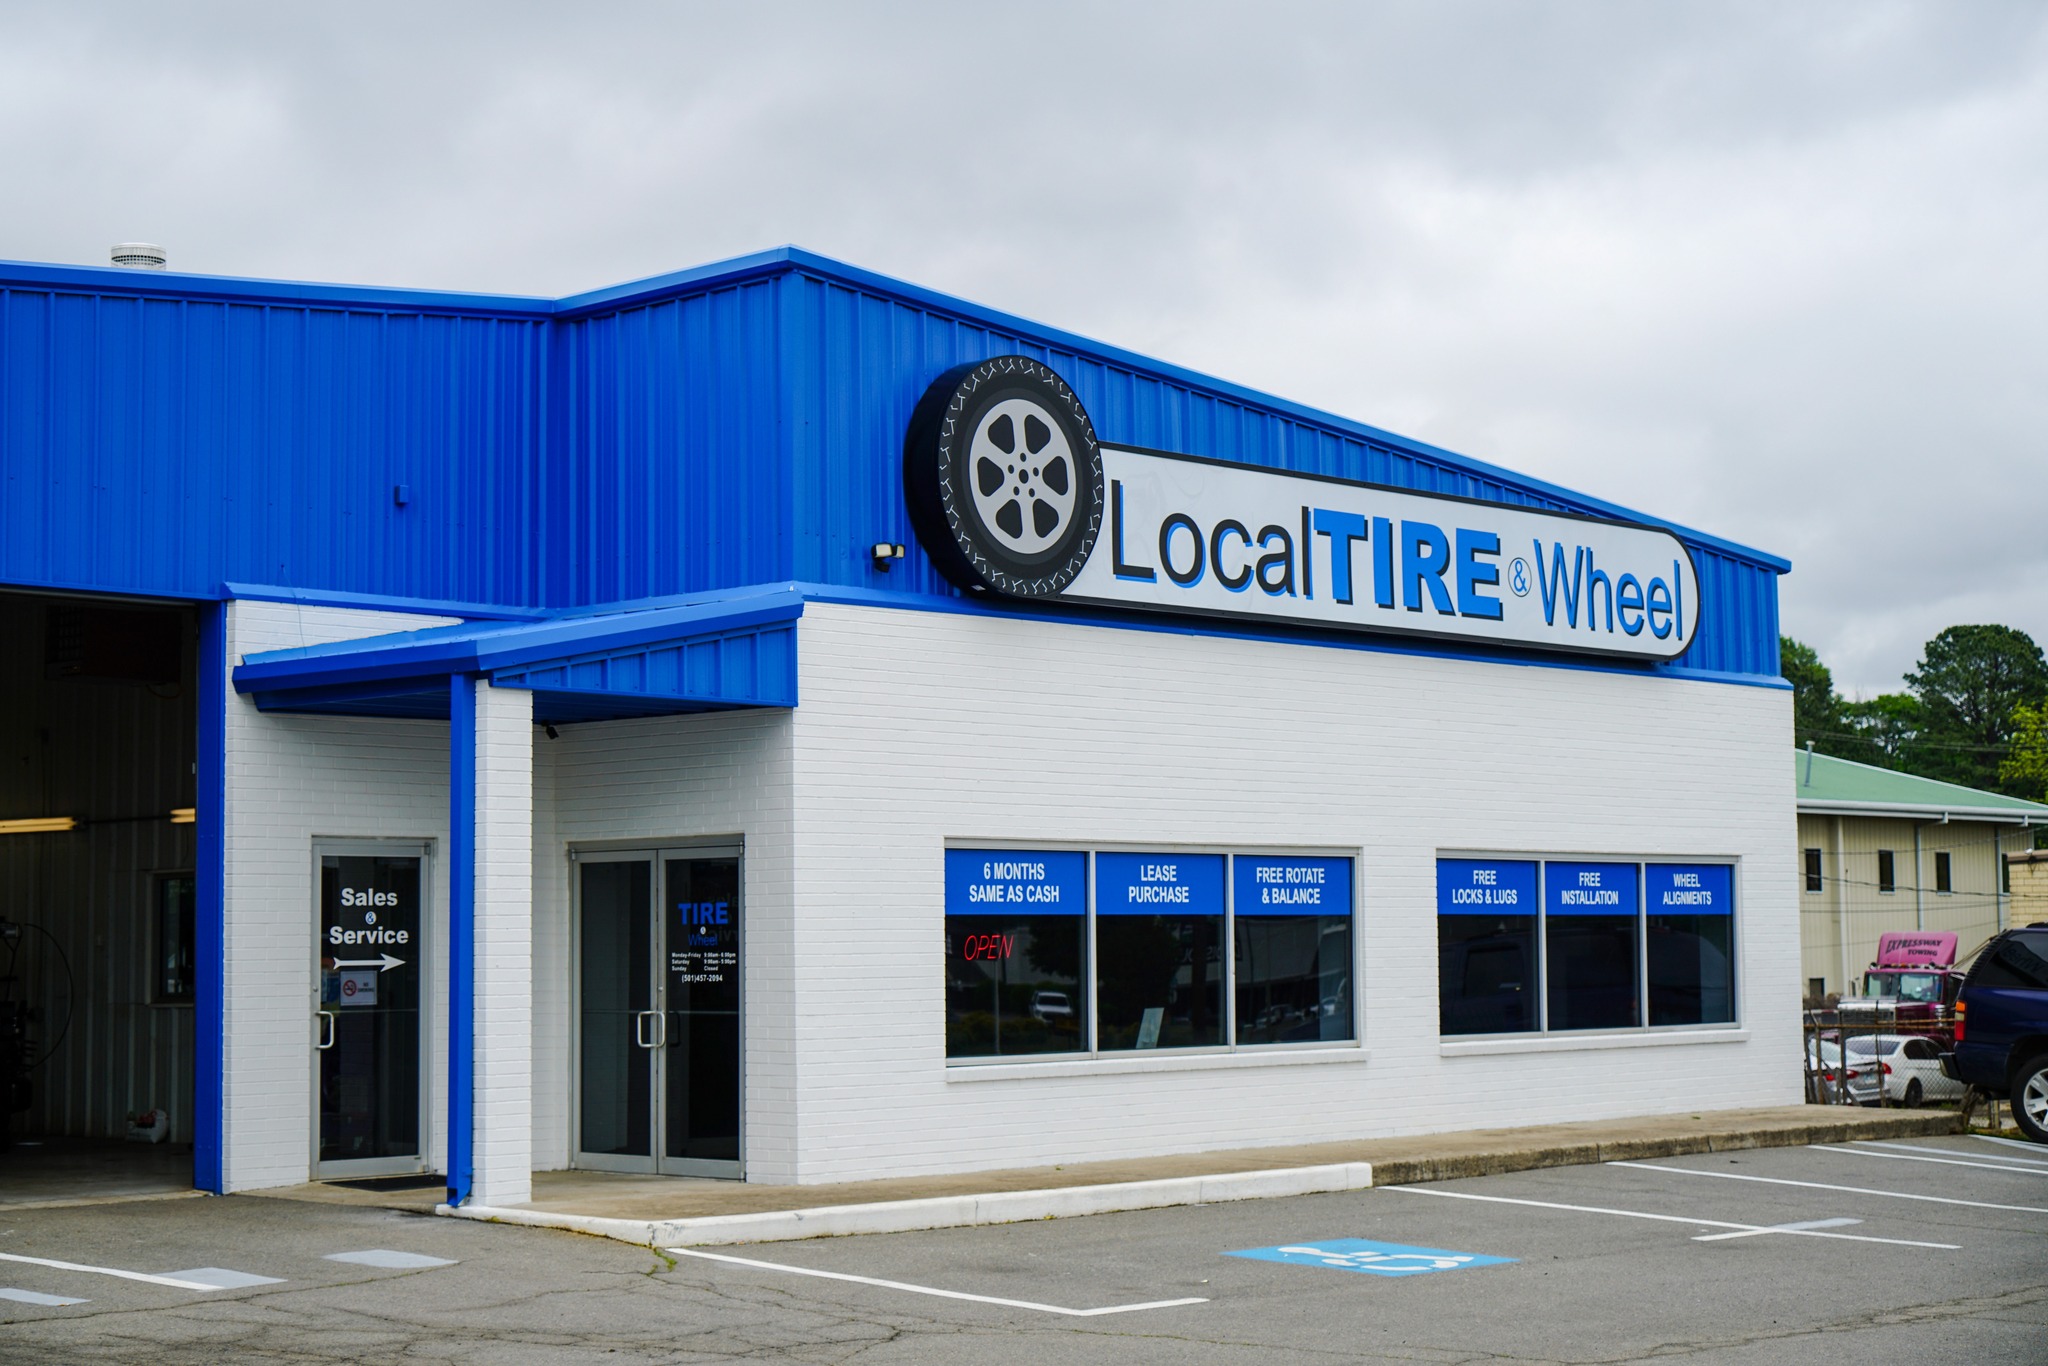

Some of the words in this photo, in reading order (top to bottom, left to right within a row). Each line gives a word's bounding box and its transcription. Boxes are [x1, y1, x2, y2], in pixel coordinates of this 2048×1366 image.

[1512, 560, 1528, 595] &
[1533, 538, 1685, 642] Wheel
[983, 862, 991, 880] 6
[994, 862, 1045, 880] MONTHS
[1140, 865, 1177, 882] LEASE
[1256, 867, 1283, 883] FREE
[1286, 867, 1325, 884] ROTATE
[1473, 870, 1497, 885] FREE
[1579, 872, 1601, 887] FREE
[1673, 873, 1701, 888] WHEEL
[341, 887, 398, 906] Sales
[969, 884, 1004, 903] SAME
[1006, 885, 1024, 903] AS
[1026, 885, 1060, 903] CASH
[1128, 886, 1189, 904] PURCHASE
[1262, 888, 1270, 904] &
[1272, 888, 1321, 905] BALANCE
[1452, 888, 1484, 905] LOCKS
[1485, 889, 1492, 905] &
[1493, 889, 1518, 905] LUGS
[1561, 890, 1619, 906] INSTALLATION
[1663, 891, 1712, 906] ALIGNMENTS
[366, 911, 376, 924] &
[678, 902, 728, 925] TIRE
[329, 926, 409, 945] Service
[688, 934, 718, 946] Wheel
[963, 934, 1015, 961] OPEN
[1885, 938, 1943, 955] EXPRESSWAY
[1907, 948, 1938, 957] TOWING
